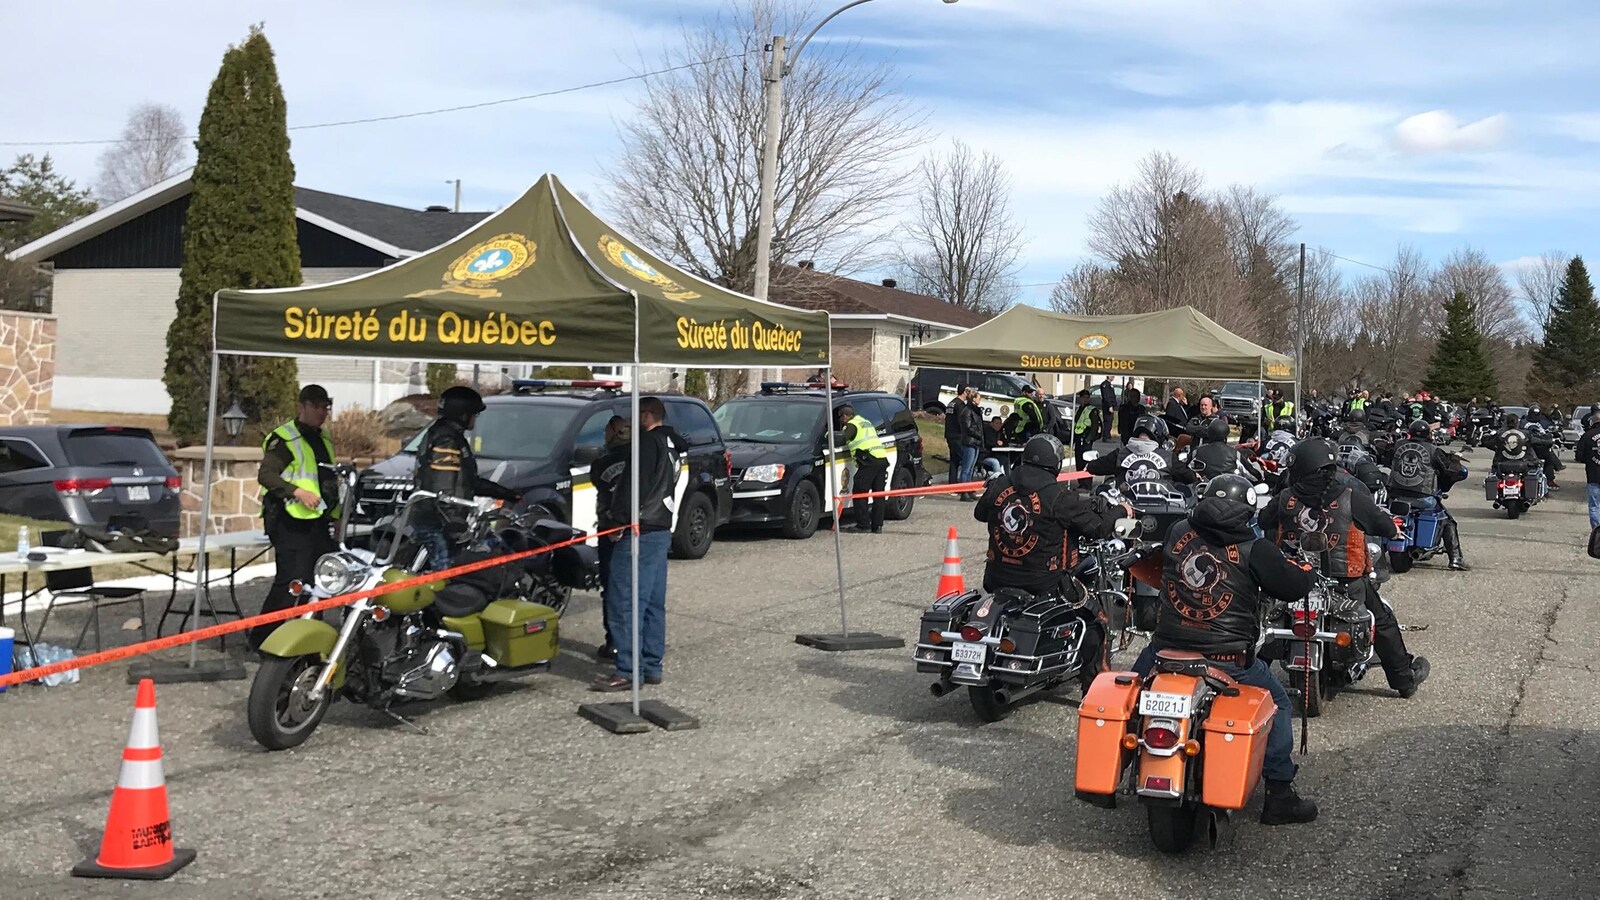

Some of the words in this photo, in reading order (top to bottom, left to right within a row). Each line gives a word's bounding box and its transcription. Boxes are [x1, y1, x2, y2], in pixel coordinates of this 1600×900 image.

[284, 306, 380, 342] Sûreté
[388, 310, 427, 342] du
[437, 312, 556, 346] Québec
[676, 316, 727, 350] Sûreté
[730, 320, 748, 350] du
[752, 320, 802, 352] Québec
[1020, 354, 1060, 368] Sûreté
[1065, 356, 1081, 369] du
[1085, 356, 1135, 370] Québec
[1146, 700, 1184, 714] 62021J
